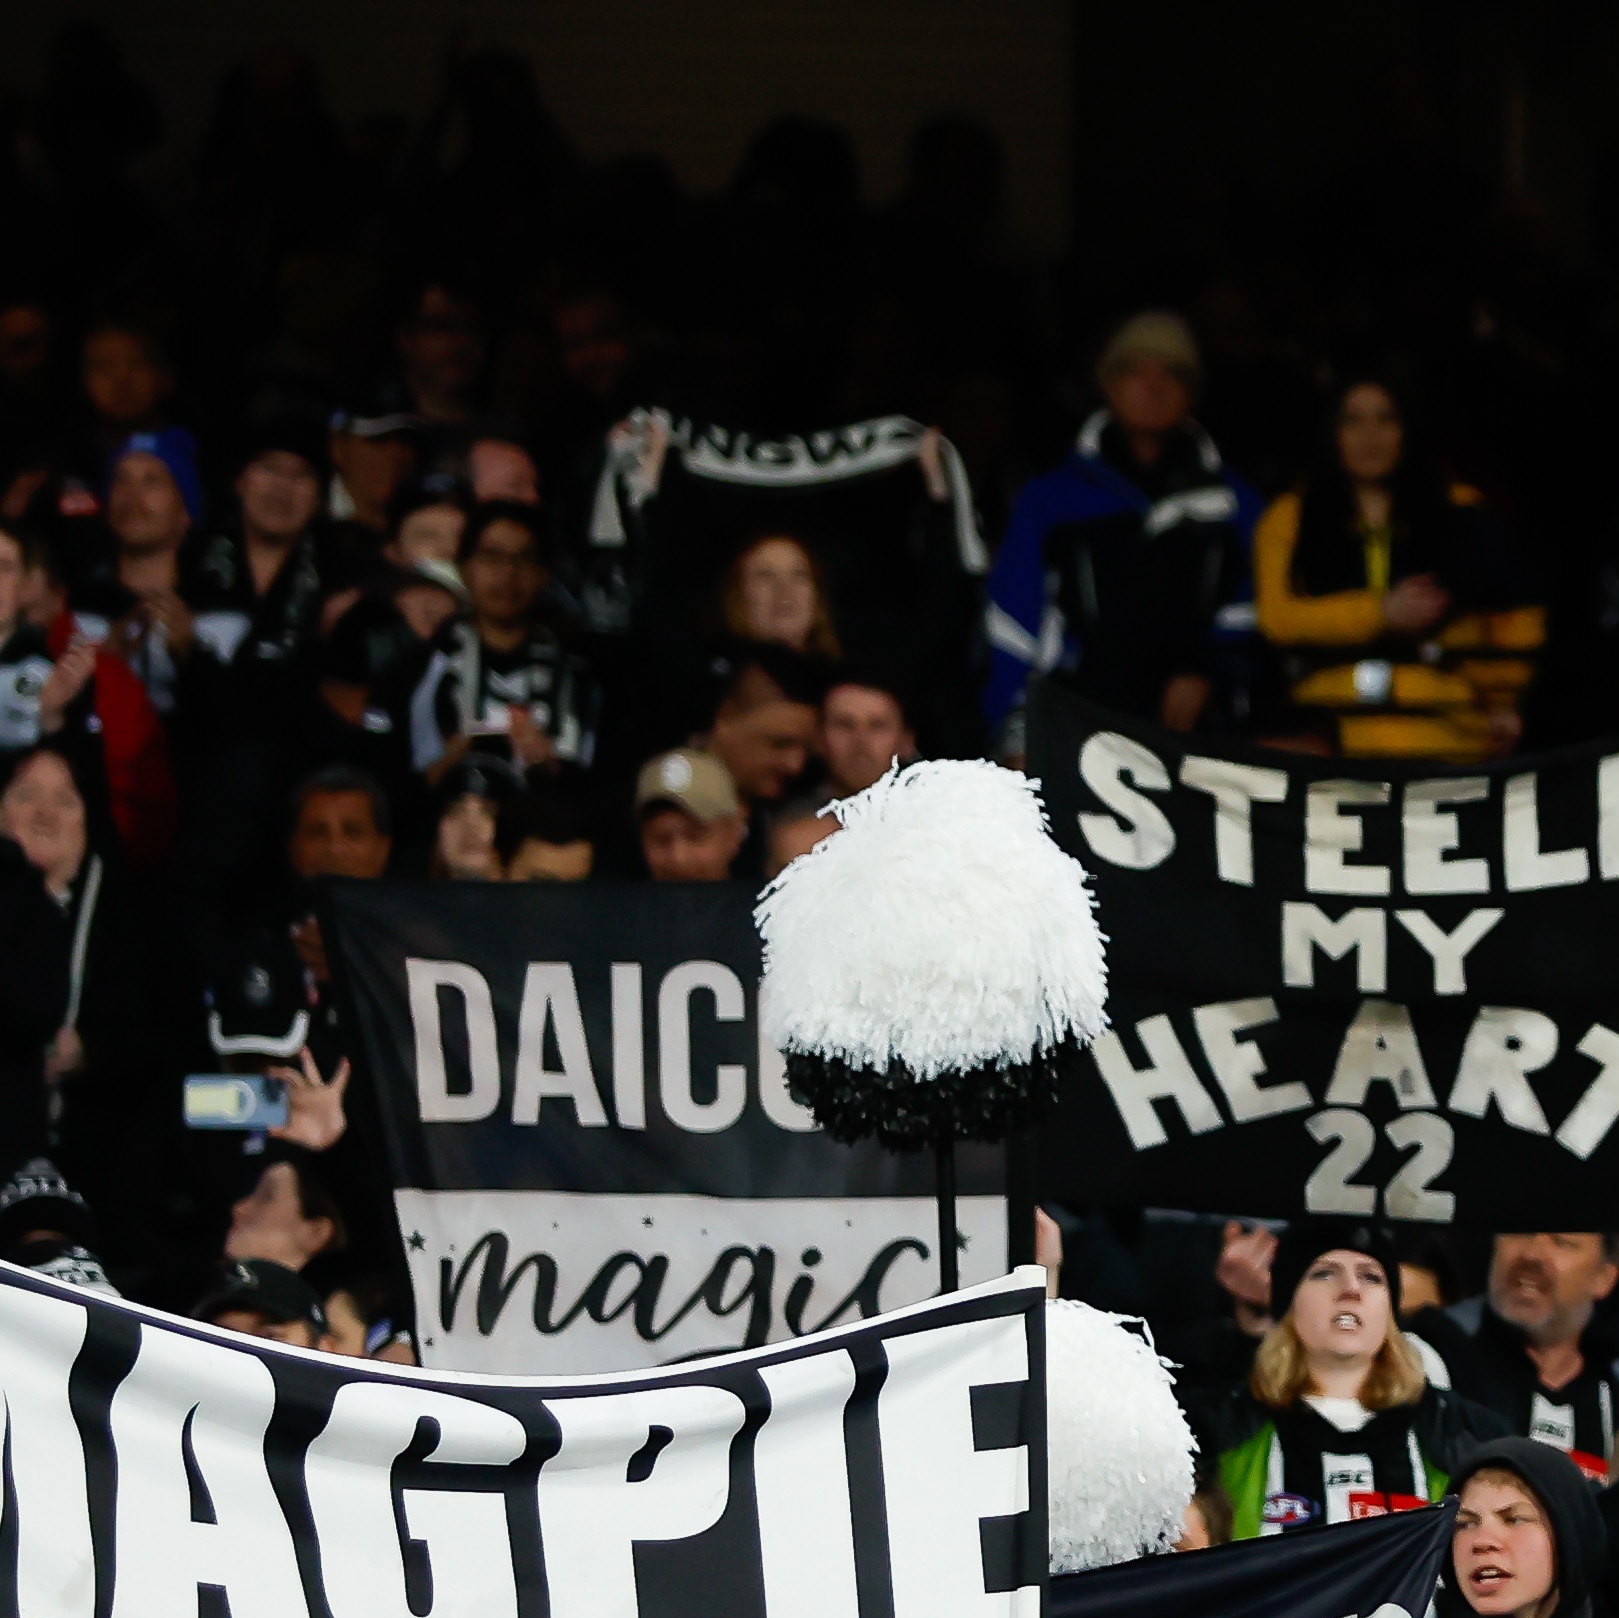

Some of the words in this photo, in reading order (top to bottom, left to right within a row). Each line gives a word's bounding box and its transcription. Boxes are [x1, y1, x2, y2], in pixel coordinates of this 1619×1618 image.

[1280, 901, 1505, 995] MY
[405, 957, 824, 1134] DAIC
[1304, 1107, 1455, 1223] 22
[439, 1230, 930, 1366] magic
